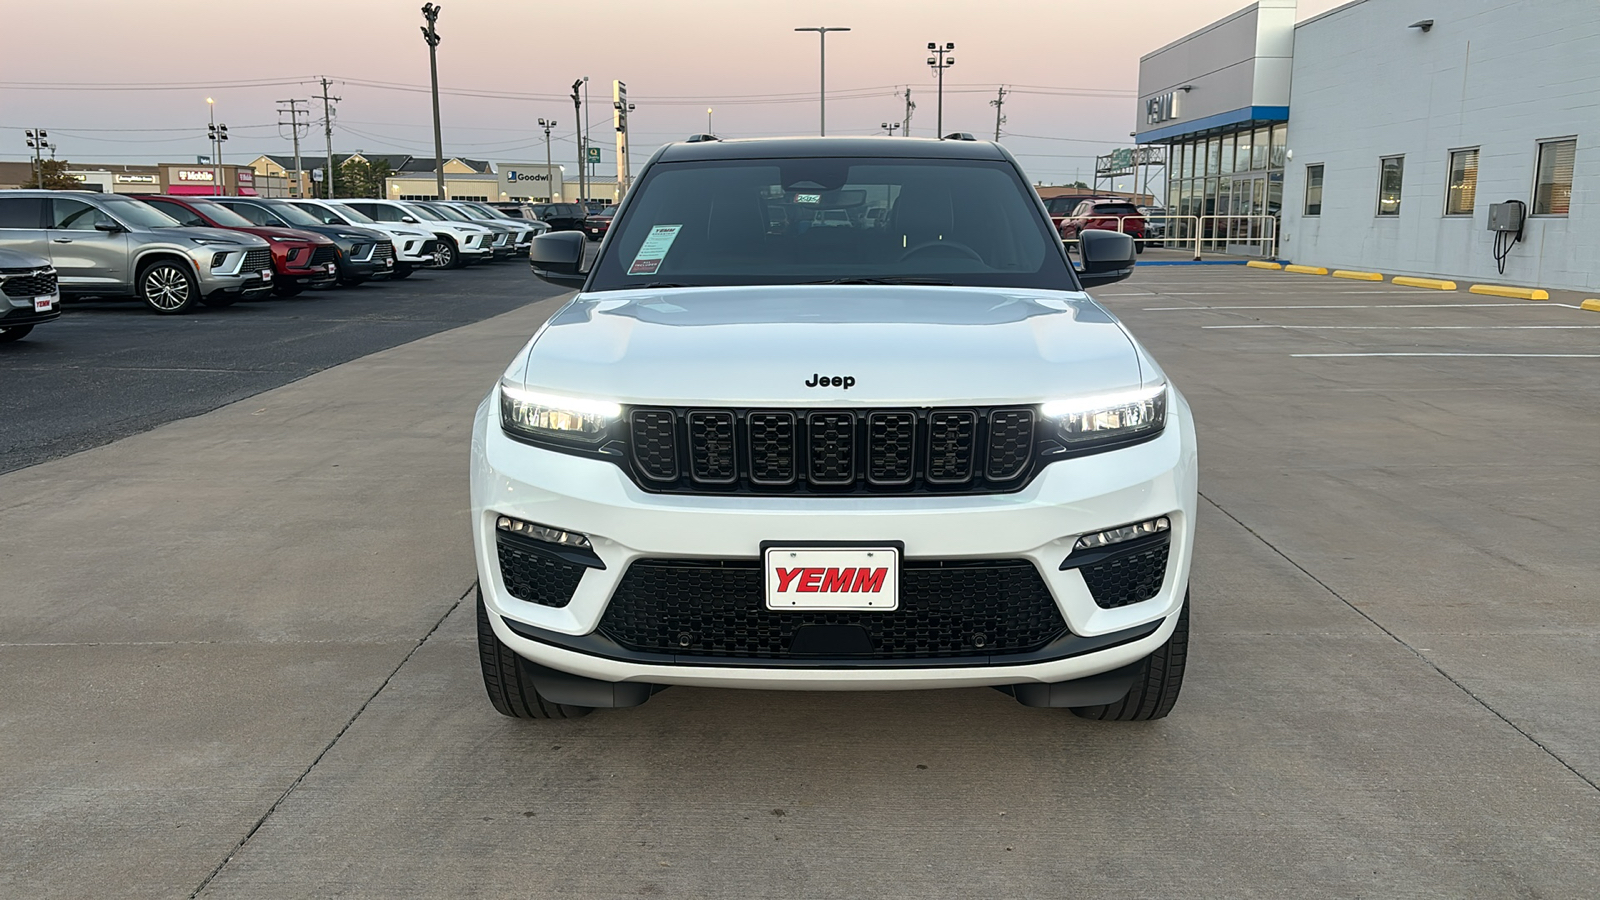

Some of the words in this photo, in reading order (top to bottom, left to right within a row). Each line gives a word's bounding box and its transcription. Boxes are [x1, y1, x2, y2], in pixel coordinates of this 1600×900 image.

[517, 173, 553, 181] Goodwil
[805, 373, 855, 389] Jeep
[776, 568, 888, 592] YEMM
